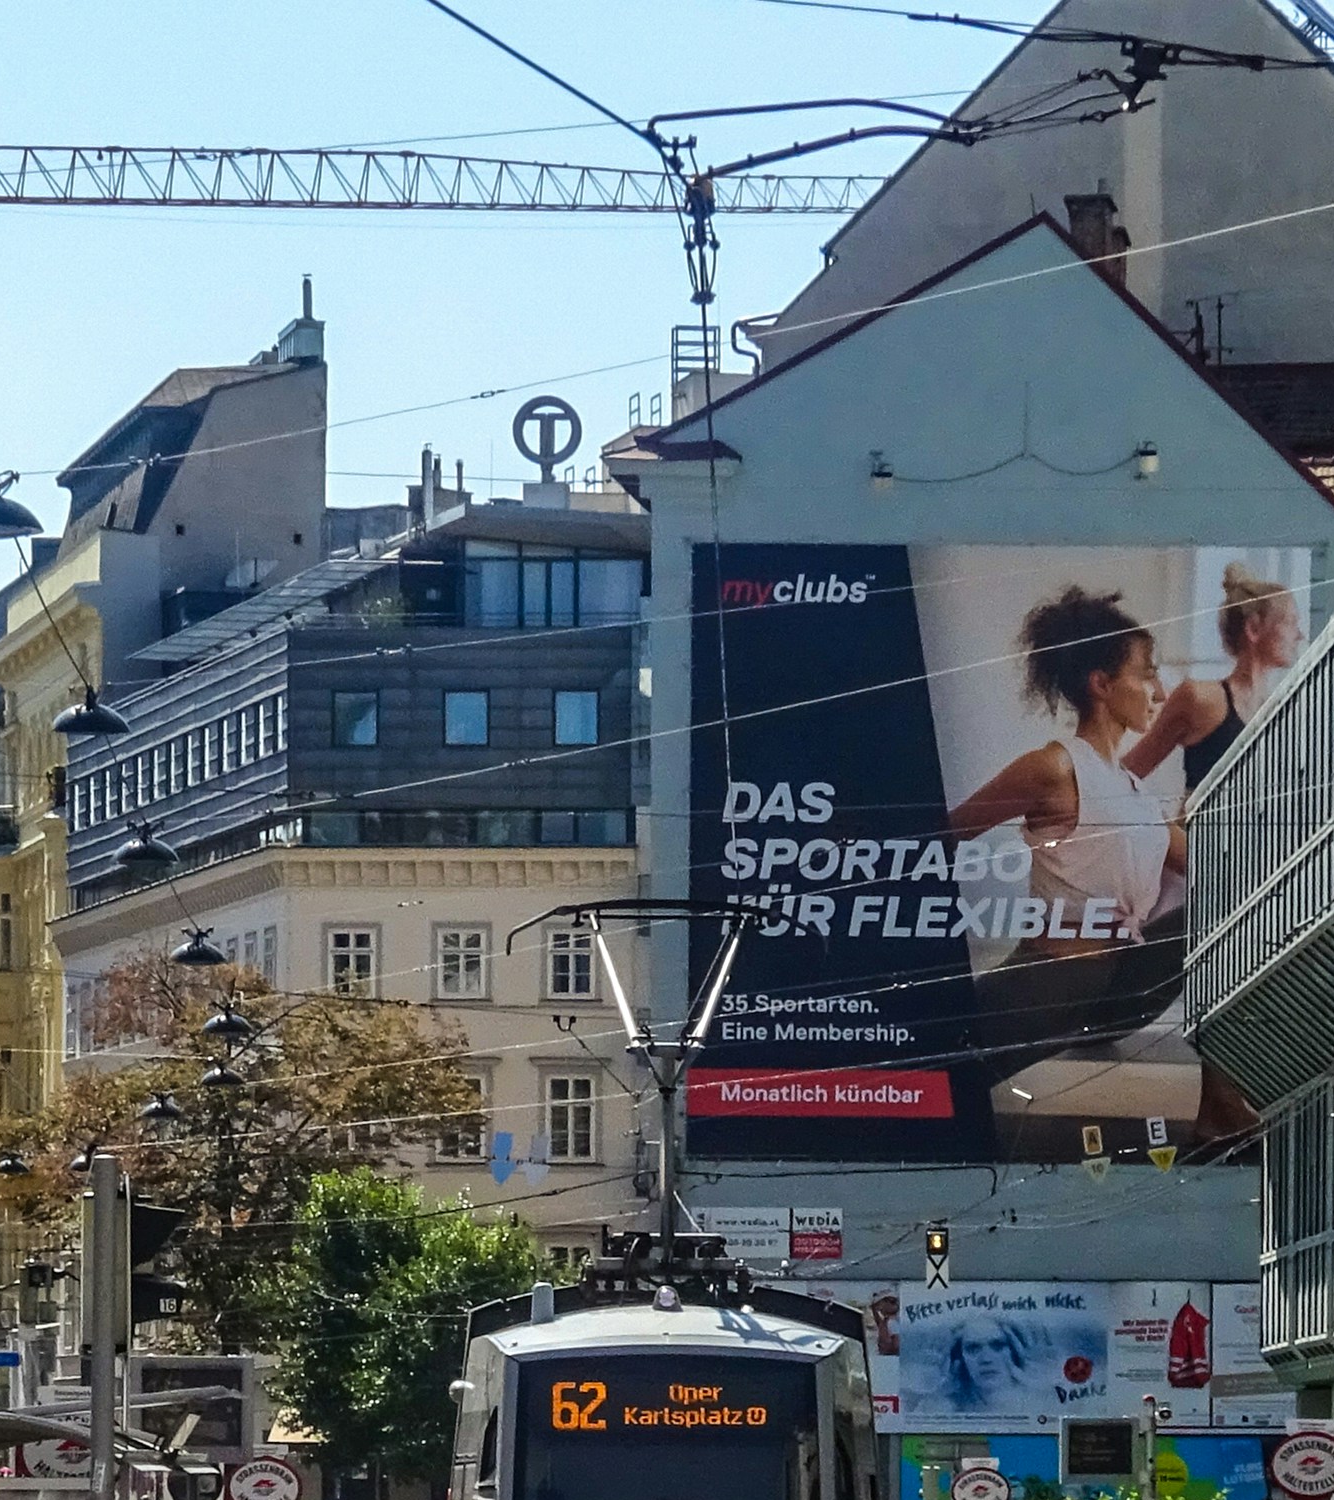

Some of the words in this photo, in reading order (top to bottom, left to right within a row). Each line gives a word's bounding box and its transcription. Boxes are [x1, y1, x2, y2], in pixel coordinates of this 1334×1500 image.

[722, 573, 868, 608] myclubs
[721, 781, 836, 823] DAS
[720, 838, 1033, 882] SPORTABO
[848, 895, 1132, 939] FLEXIBLE.
[721, 994, 748, 1013] 35
[754, 994, 880, 1017] Sportarten.
[721, 1021, 768, 1041] Eine
[774, 1022, 916, 1046] Membership.
[720, 1083, 828, 1104] Monatlich
[833, 1083, 923, 1104] kündbar
[163, 1299, 176, 1312] 16
[905, 1301, 944, 1324] Bitte
[669, 1383, 724, 1405] Oper
[1054, 1383, 1107, 1404] Danke
[551, 1381, 607, 1431] 62
[624, 1406, 744, 1428] Karlsplatz
